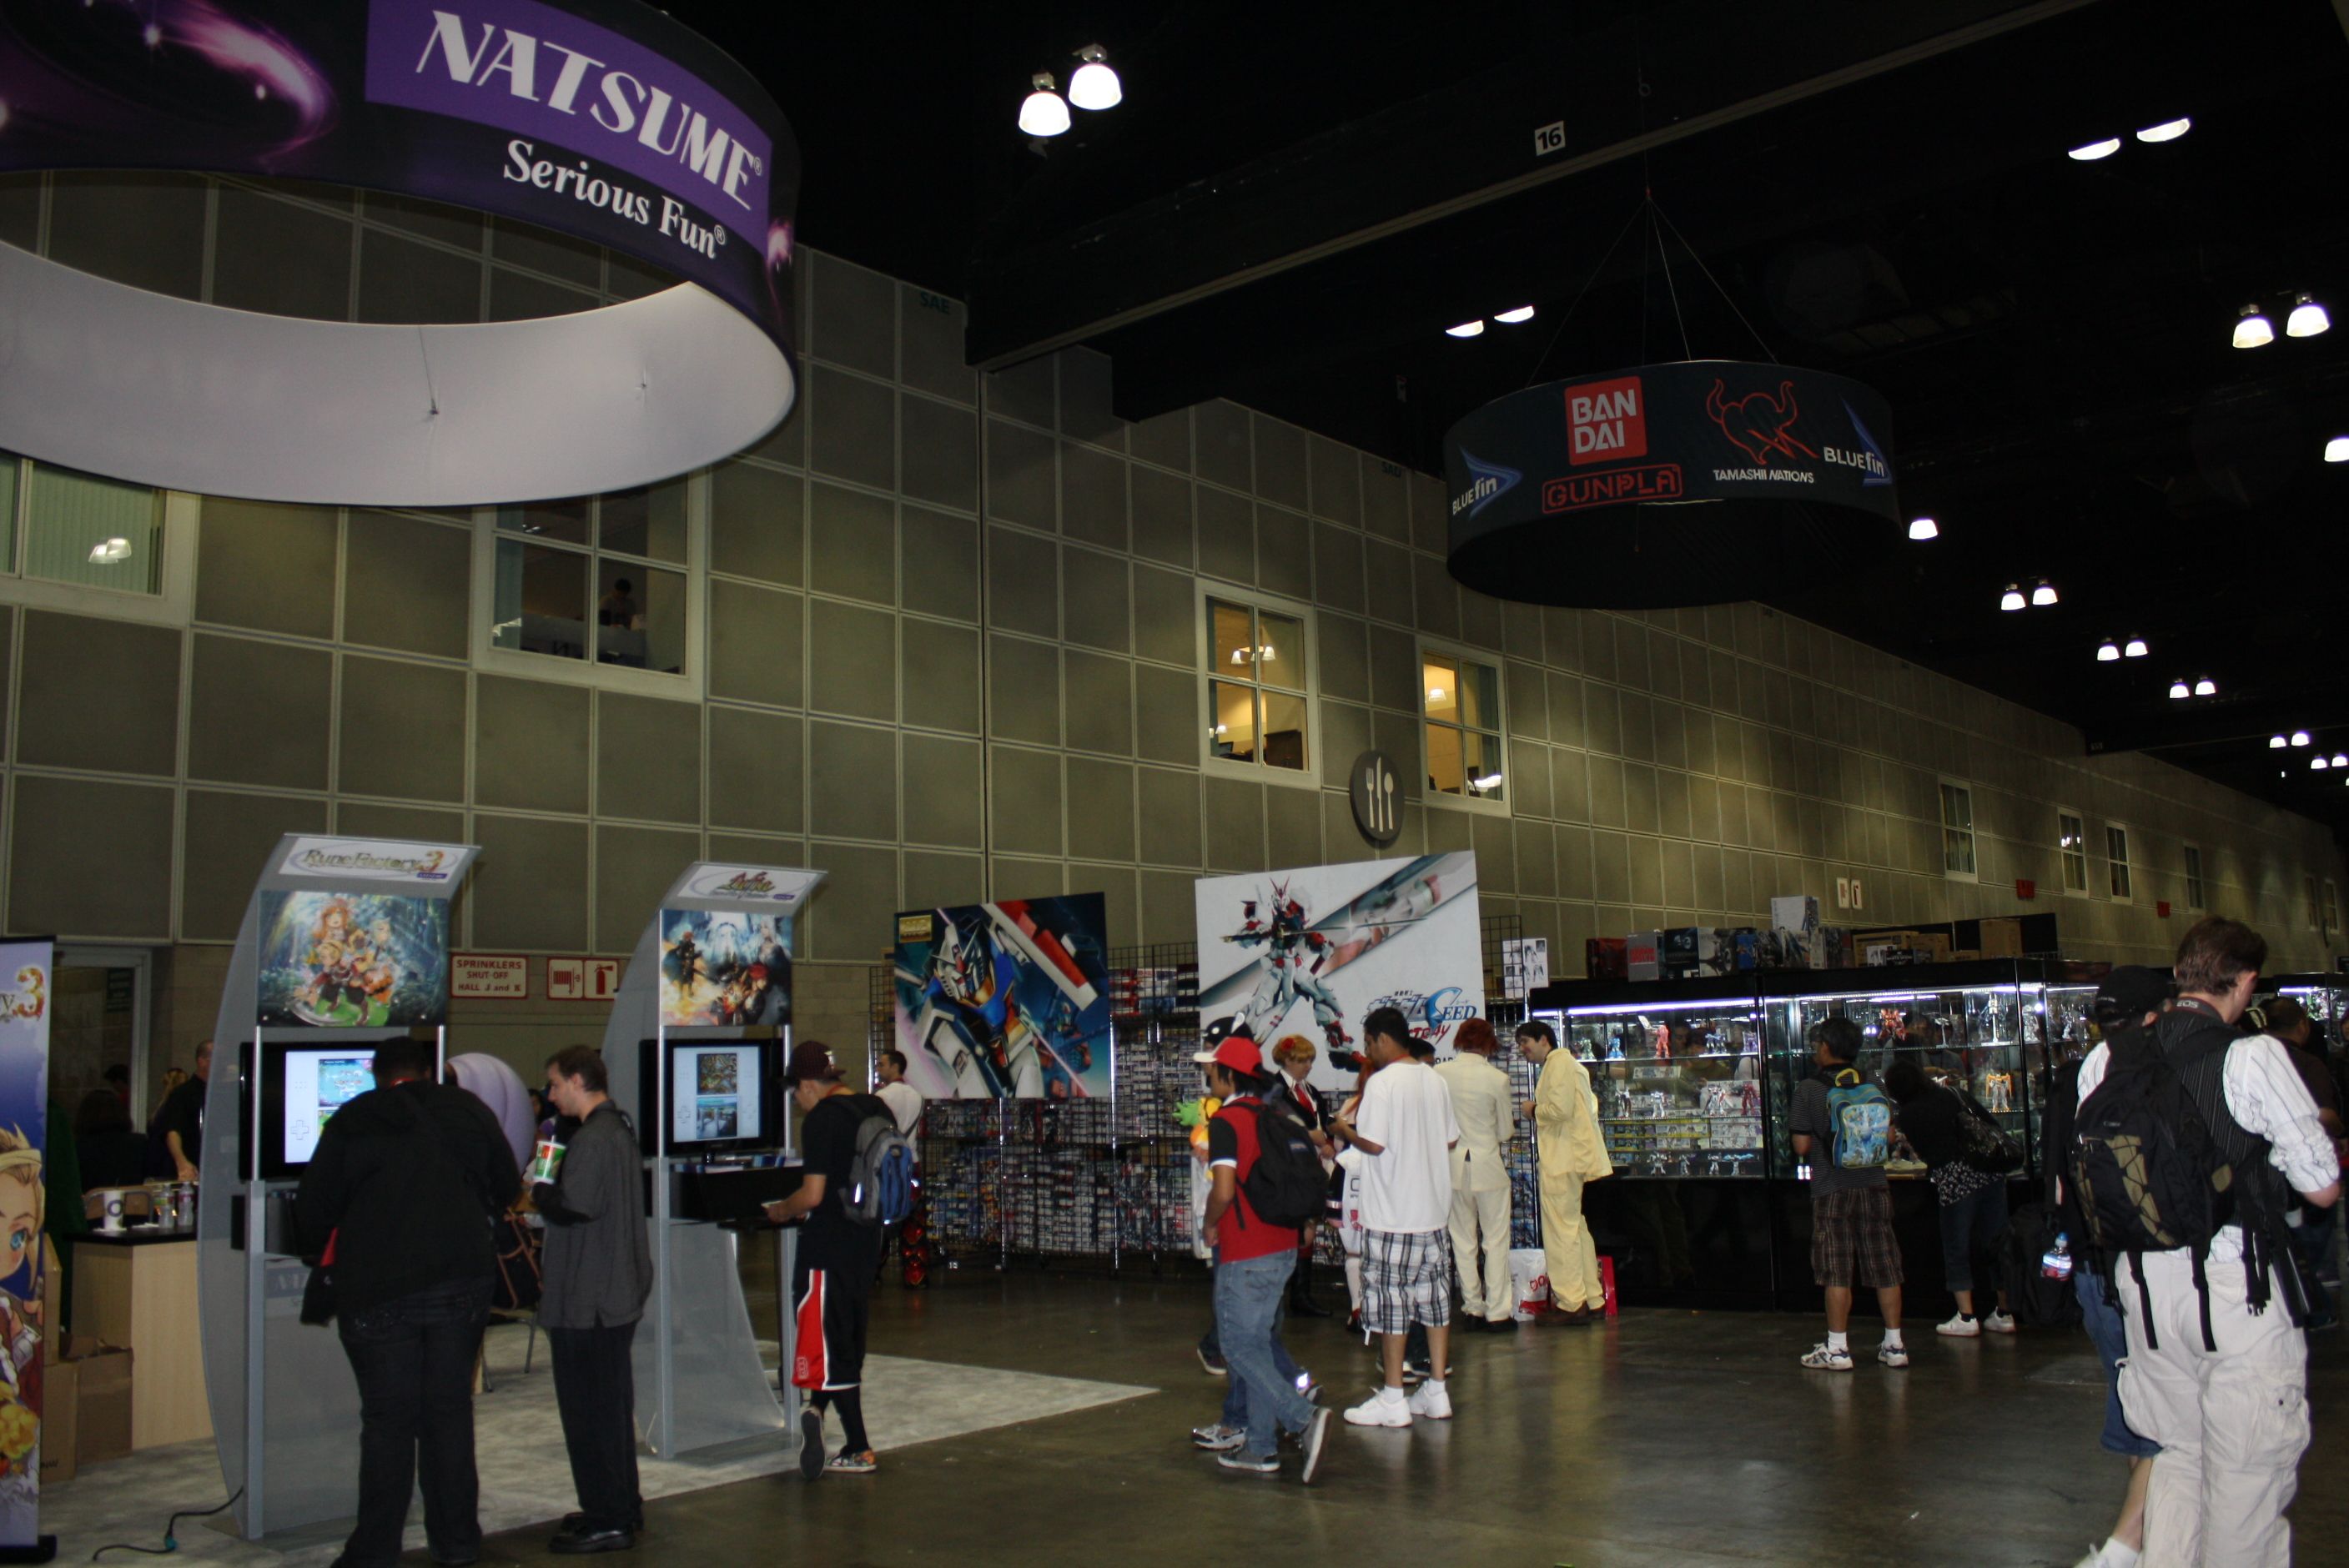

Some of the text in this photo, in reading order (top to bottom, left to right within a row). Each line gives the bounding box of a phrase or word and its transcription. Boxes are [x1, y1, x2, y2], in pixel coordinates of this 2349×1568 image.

[1537, 127, 1562, 150] 16
[504, 139, 650, 225] Serious
[1572, 389, 1637, 425] BAN
[1574, 420, 1625, 454] DAI
[1547, 470, 1677, 507] GUNPLA
[1713, 469, 1814, 483] TAMASHII NATIONS
[456, 959, 521, 969] SPRINKLERS
[13, 968, 45, 1018] 3
